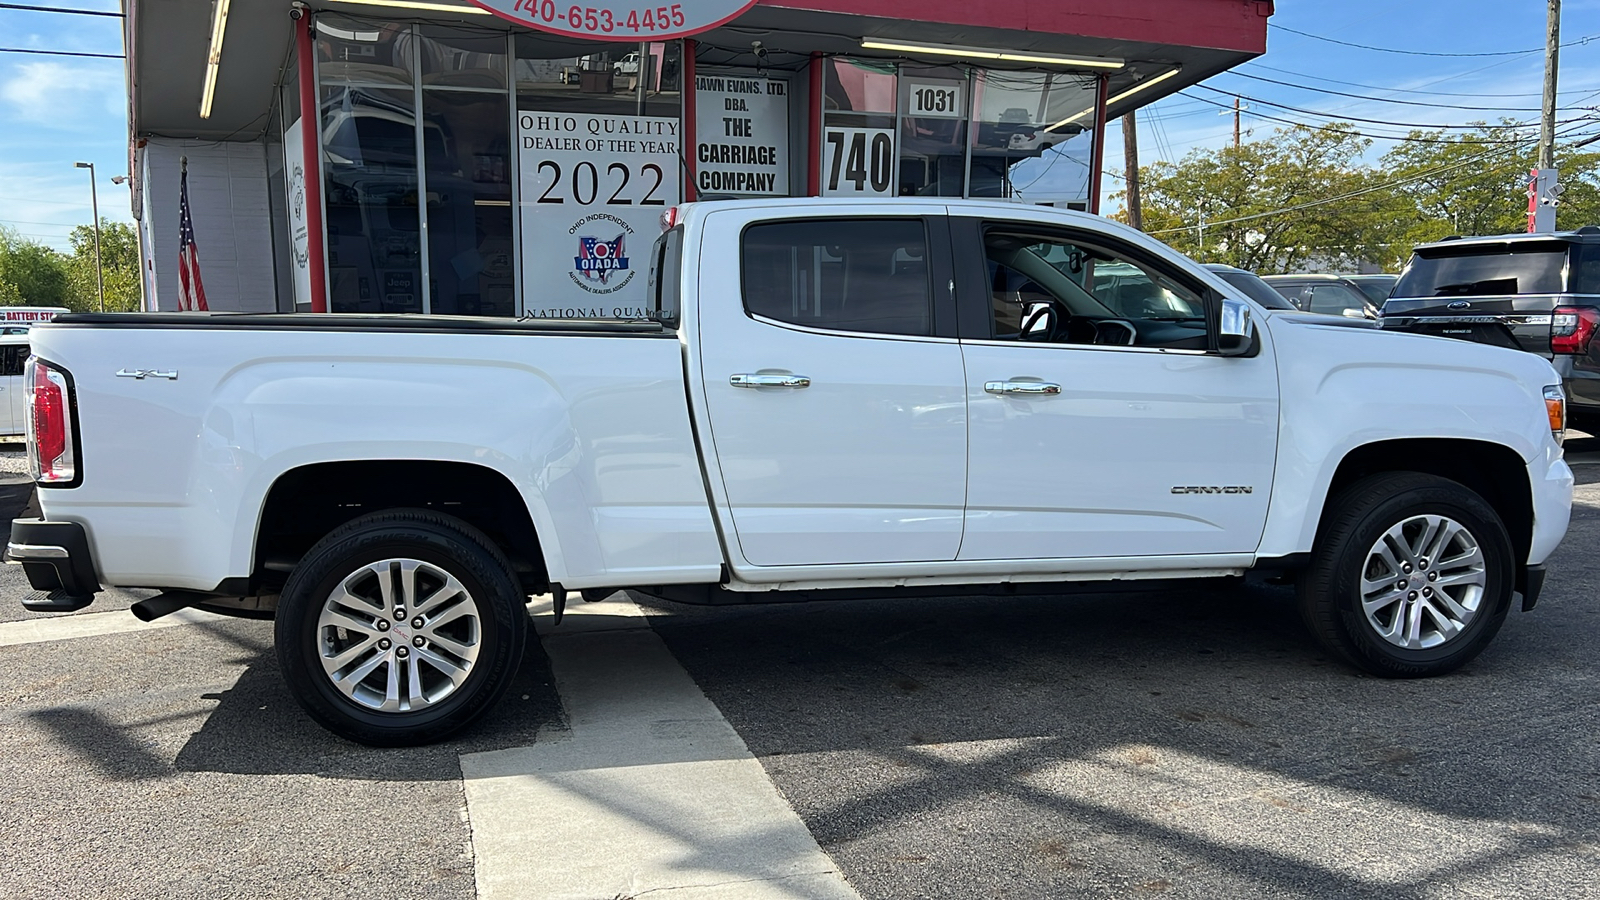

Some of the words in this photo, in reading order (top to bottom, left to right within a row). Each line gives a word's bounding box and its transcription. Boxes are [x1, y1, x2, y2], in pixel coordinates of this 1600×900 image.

[727, 80, 762, 95] EVANS.
[767, 82, 786, 96] LTD.
[725, 98, 749, 112] DBA.
[915, 89, 955, 112] 1031
[520, 115, 577, 132] OHIO
[587, 118, 678, 136] QUALITY
[723, 117, 752, 137] THE
[523, 136, 582, 151] DEALER
[585, 138, 604, 151] OF
[607, 139, 636, 153] THE
[640, 141, 676, 154] YEAR
[698, 143, 776, 165] CARRIAGE
[827, 131, 892, 192] 740
[537, 160, 665, 206] 2022
[700, 170, 775, 192] COMPANY
[568, 218, 586, 235] OHIO
[585, 213, 635, 235] INDEPENDENT
[581, 258, 620, 270] OIADA
[387, 278, 411, 288] Jeep
[568, 271, 592, 293] AUTOMOBILE
[612, 270, 636, 293] ASSOCIATION
[6, 311, 39, 321] BATTERY
[527, 308, 606, 318] NATIONAL
[1170, 485, 1253, 495] CANYON
[392, 627, 409, 640] GMC
